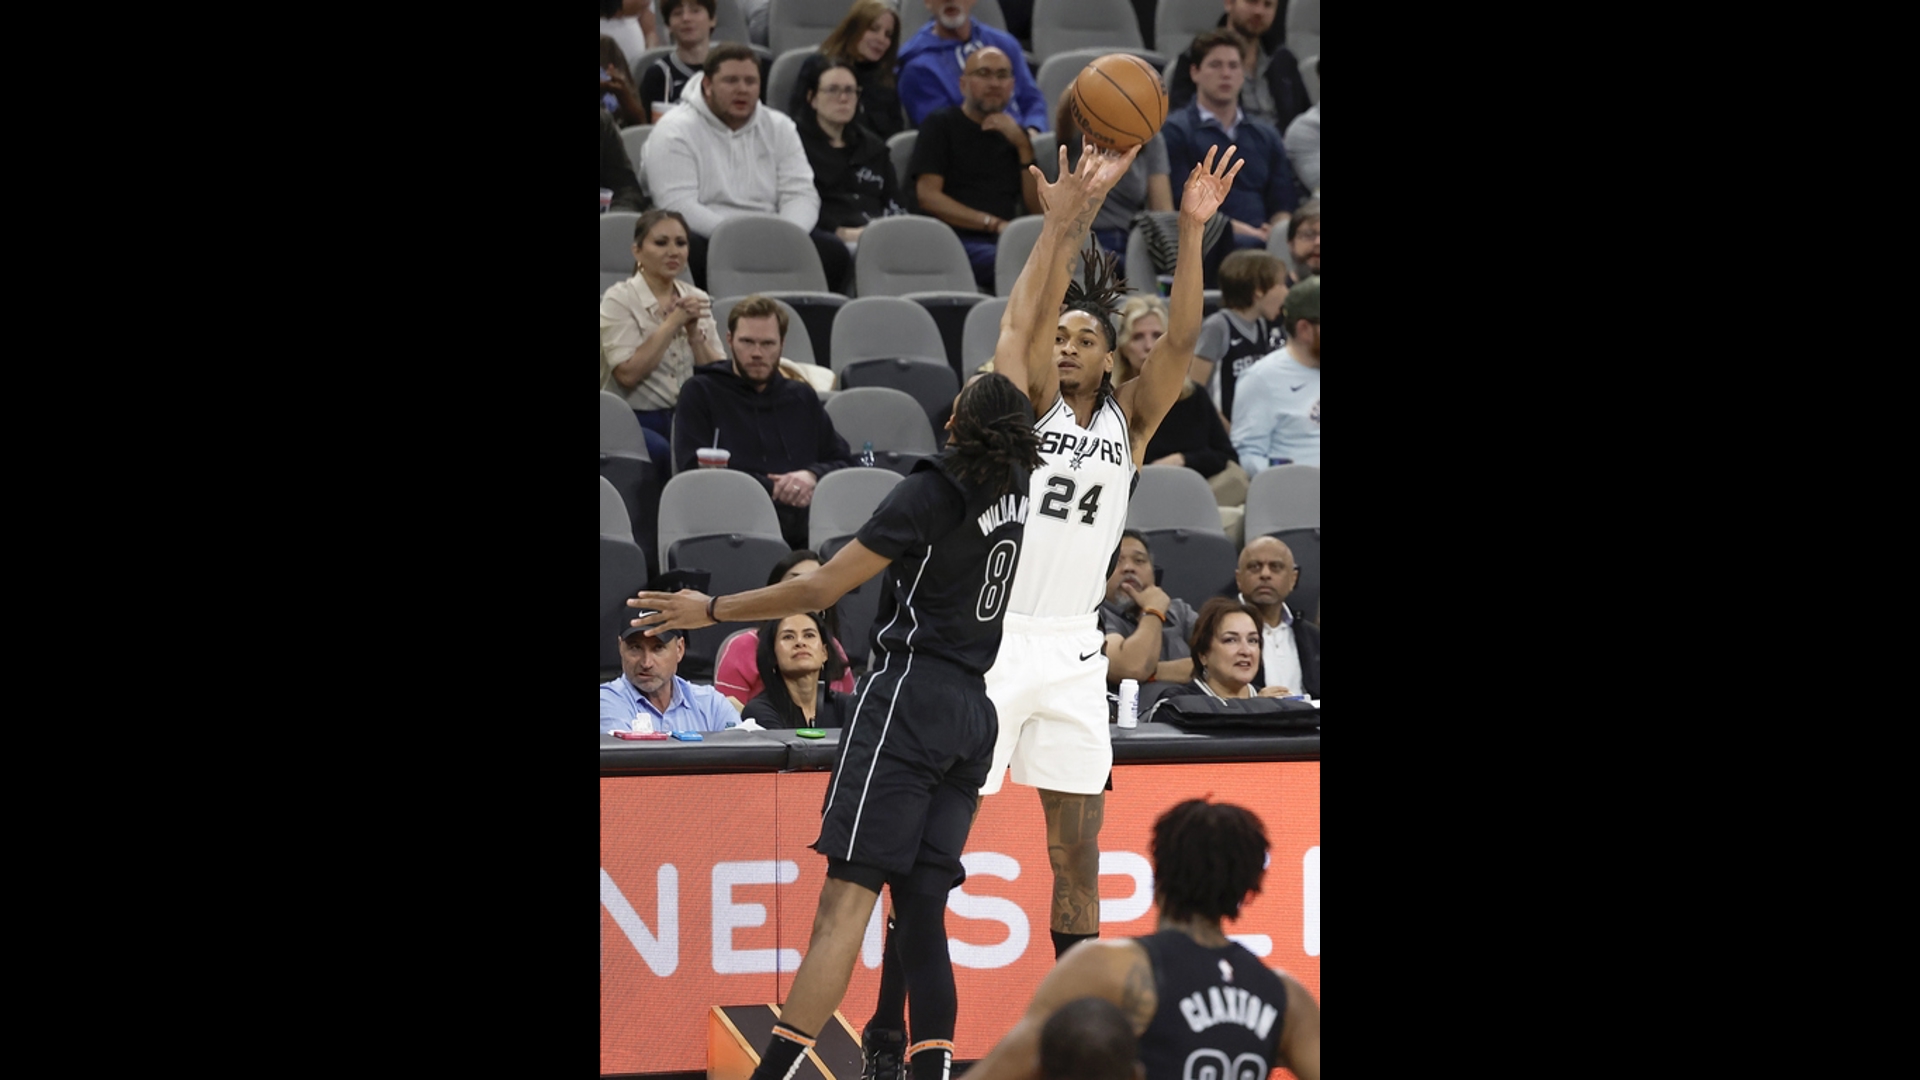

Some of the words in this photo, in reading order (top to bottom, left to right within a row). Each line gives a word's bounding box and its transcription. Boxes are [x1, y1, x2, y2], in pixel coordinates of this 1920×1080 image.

[1039, 431, 1122, 467] SPURS
[1037, 473, 1105, 527] 24
[976, 539, 1017, 620] 8
[600, 846, 1320, 977] NESP
[1179, 985, 1279, 1040] CLAXTON
